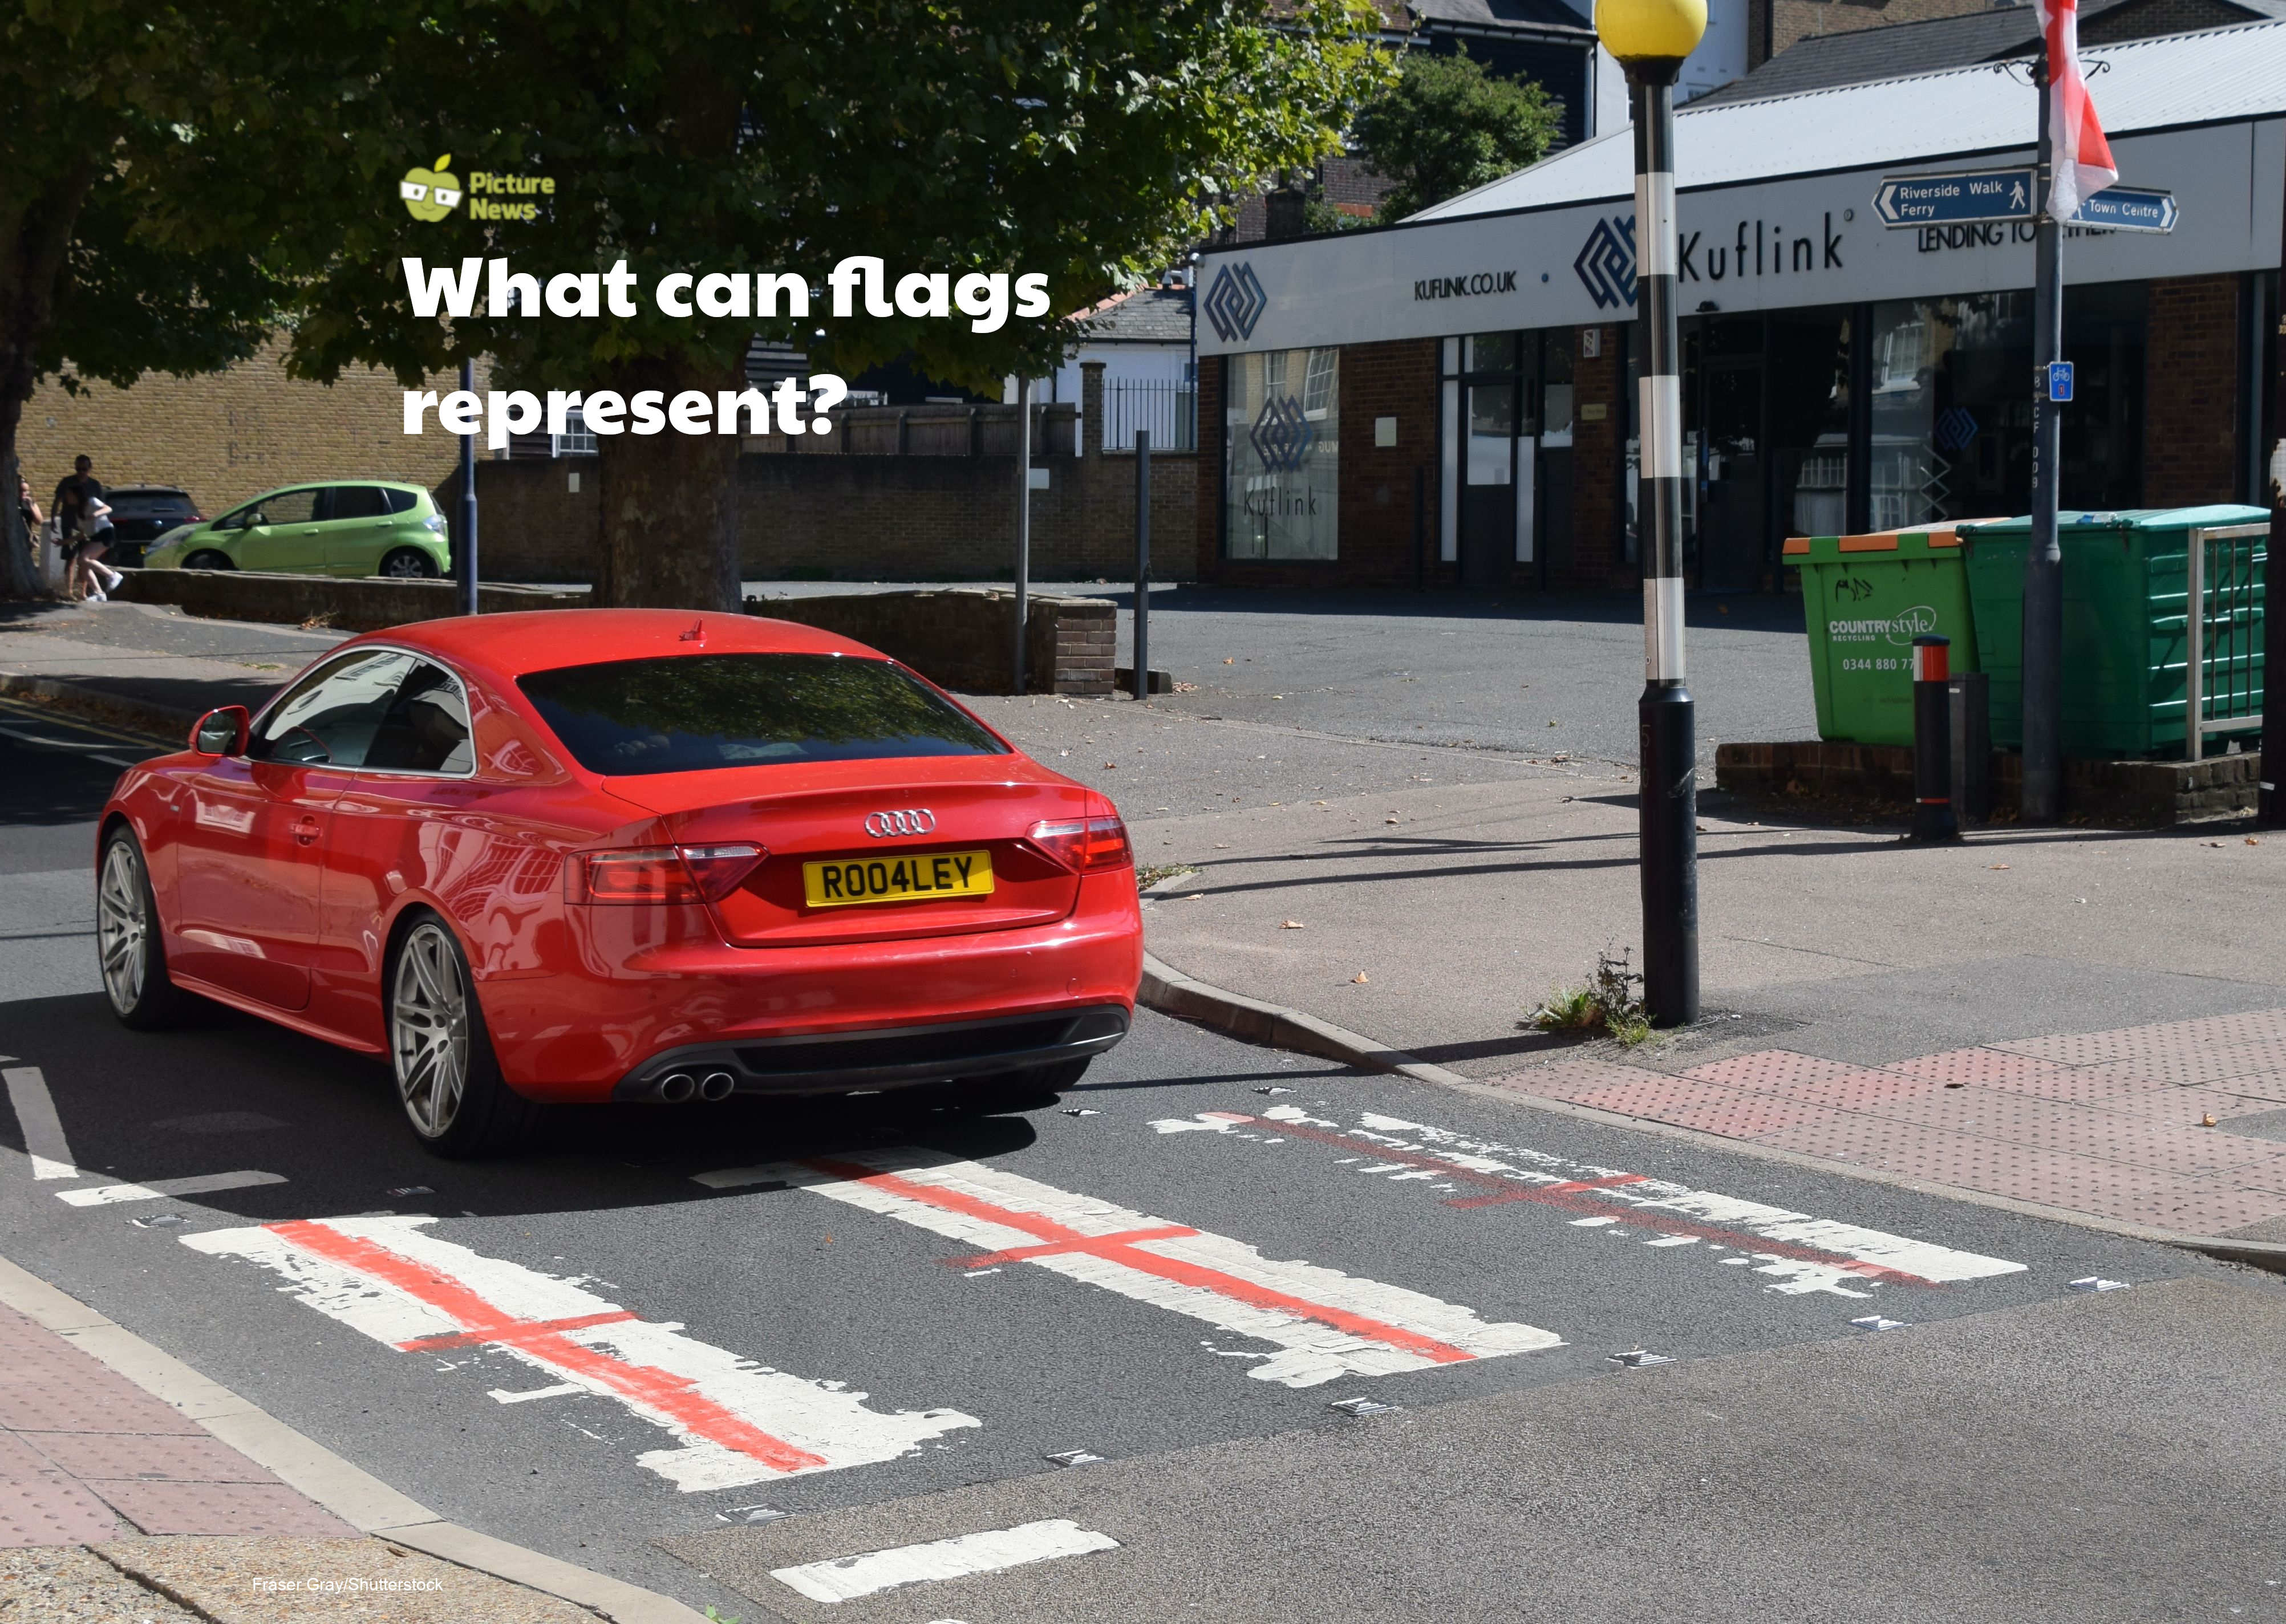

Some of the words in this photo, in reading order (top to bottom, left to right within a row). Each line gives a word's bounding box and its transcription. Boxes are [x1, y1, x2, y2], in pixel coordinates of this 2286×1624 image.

[1900, 184, 1960, 199] Riverside
[1969, 182, 2003, 194] Walk
[1901, 204, 1935, 217] Ferry
[2090, 200, 2116, 214] Town
[2122, 203, 2158, 218] Centre
[1679, 212, 1843, 283] Kuflink
[1918, 221, 2004, 253] LENDING
[1414, 270, 1517, 301] KUFLINK.CO.UK
[1244, 486, 1316, 516] Kuflink
[1843, 659, 1871, 670] 0344
[1876, 659, 1896, 670] 880
[1902, 658, 1914, 670] 77
